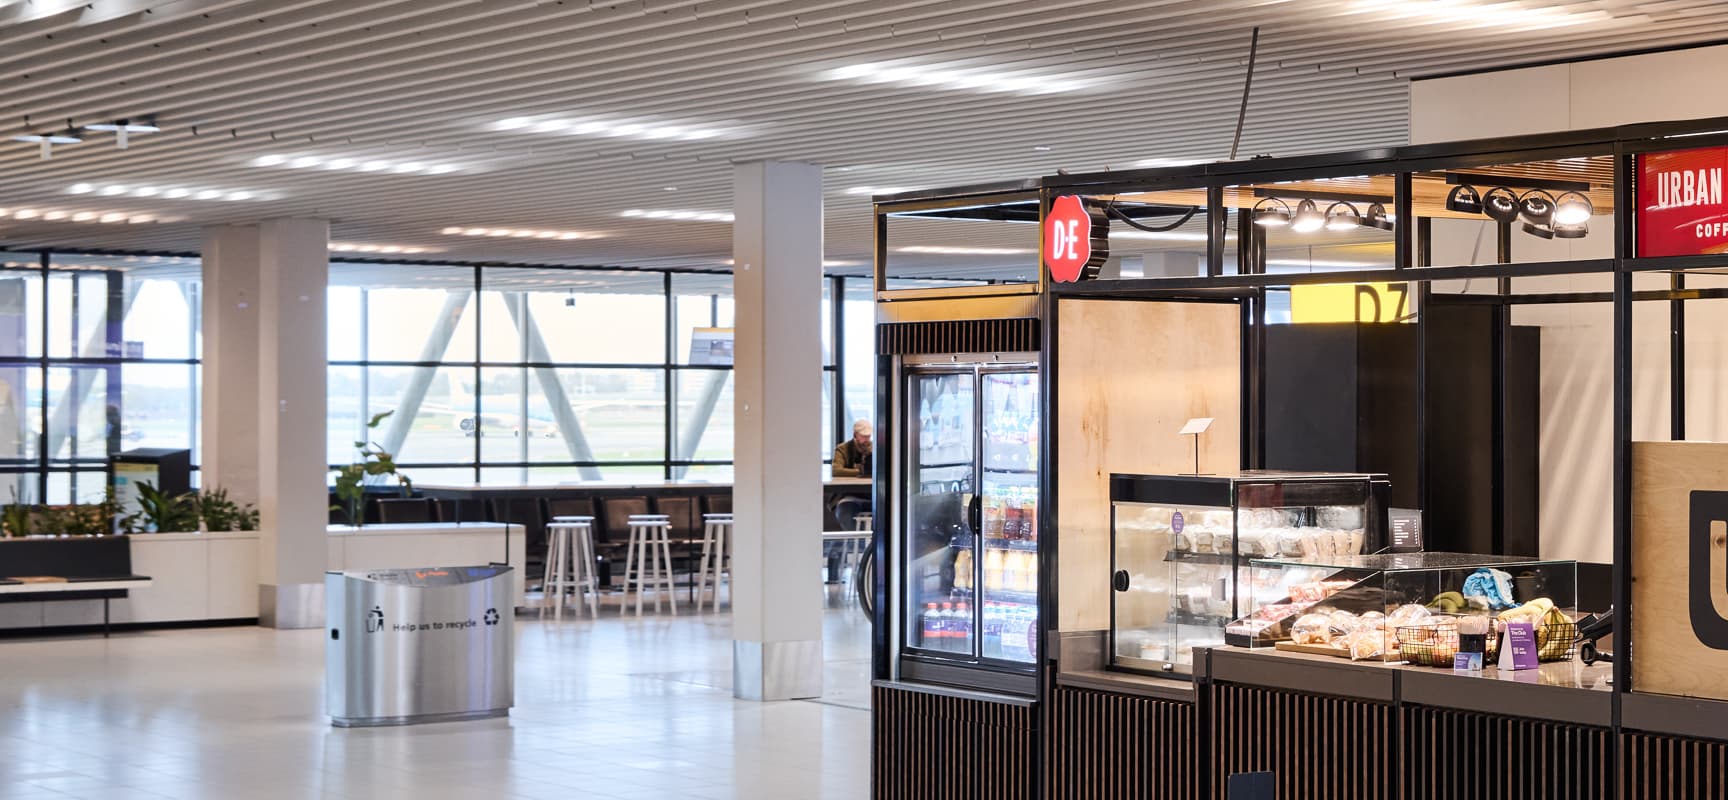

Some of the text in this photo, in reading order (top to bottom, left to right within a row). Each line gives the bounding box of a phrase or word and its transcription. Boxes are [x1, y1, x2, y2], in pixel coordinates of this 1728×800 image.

[1657, 168, 1722, 208] URBAN
[393, 618, 477, 632] Help us to recycle
